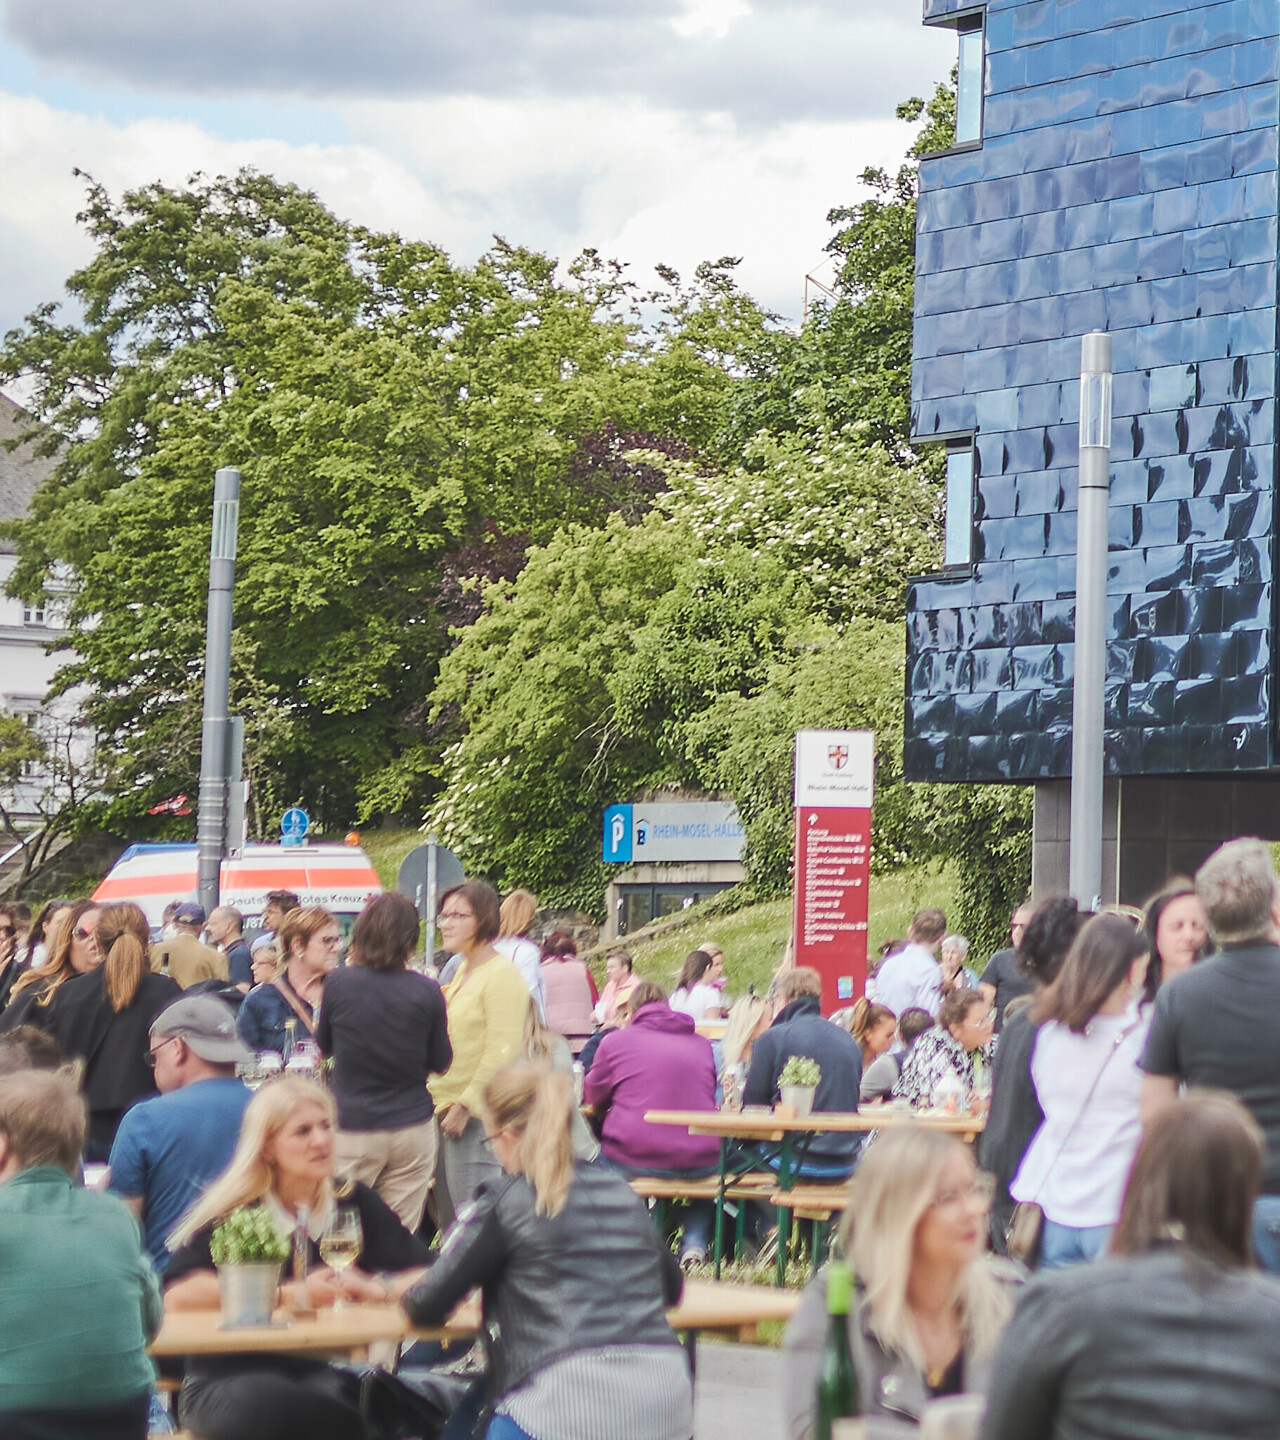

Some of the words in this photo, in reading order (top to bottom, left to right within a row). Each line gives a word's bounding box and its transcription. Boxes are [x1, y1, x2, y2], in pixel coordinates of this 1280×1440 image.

[611, 820, 625, 854] P
[298, 894, 329, 904] otes
[330, 893, 362, 903] Kreuz
